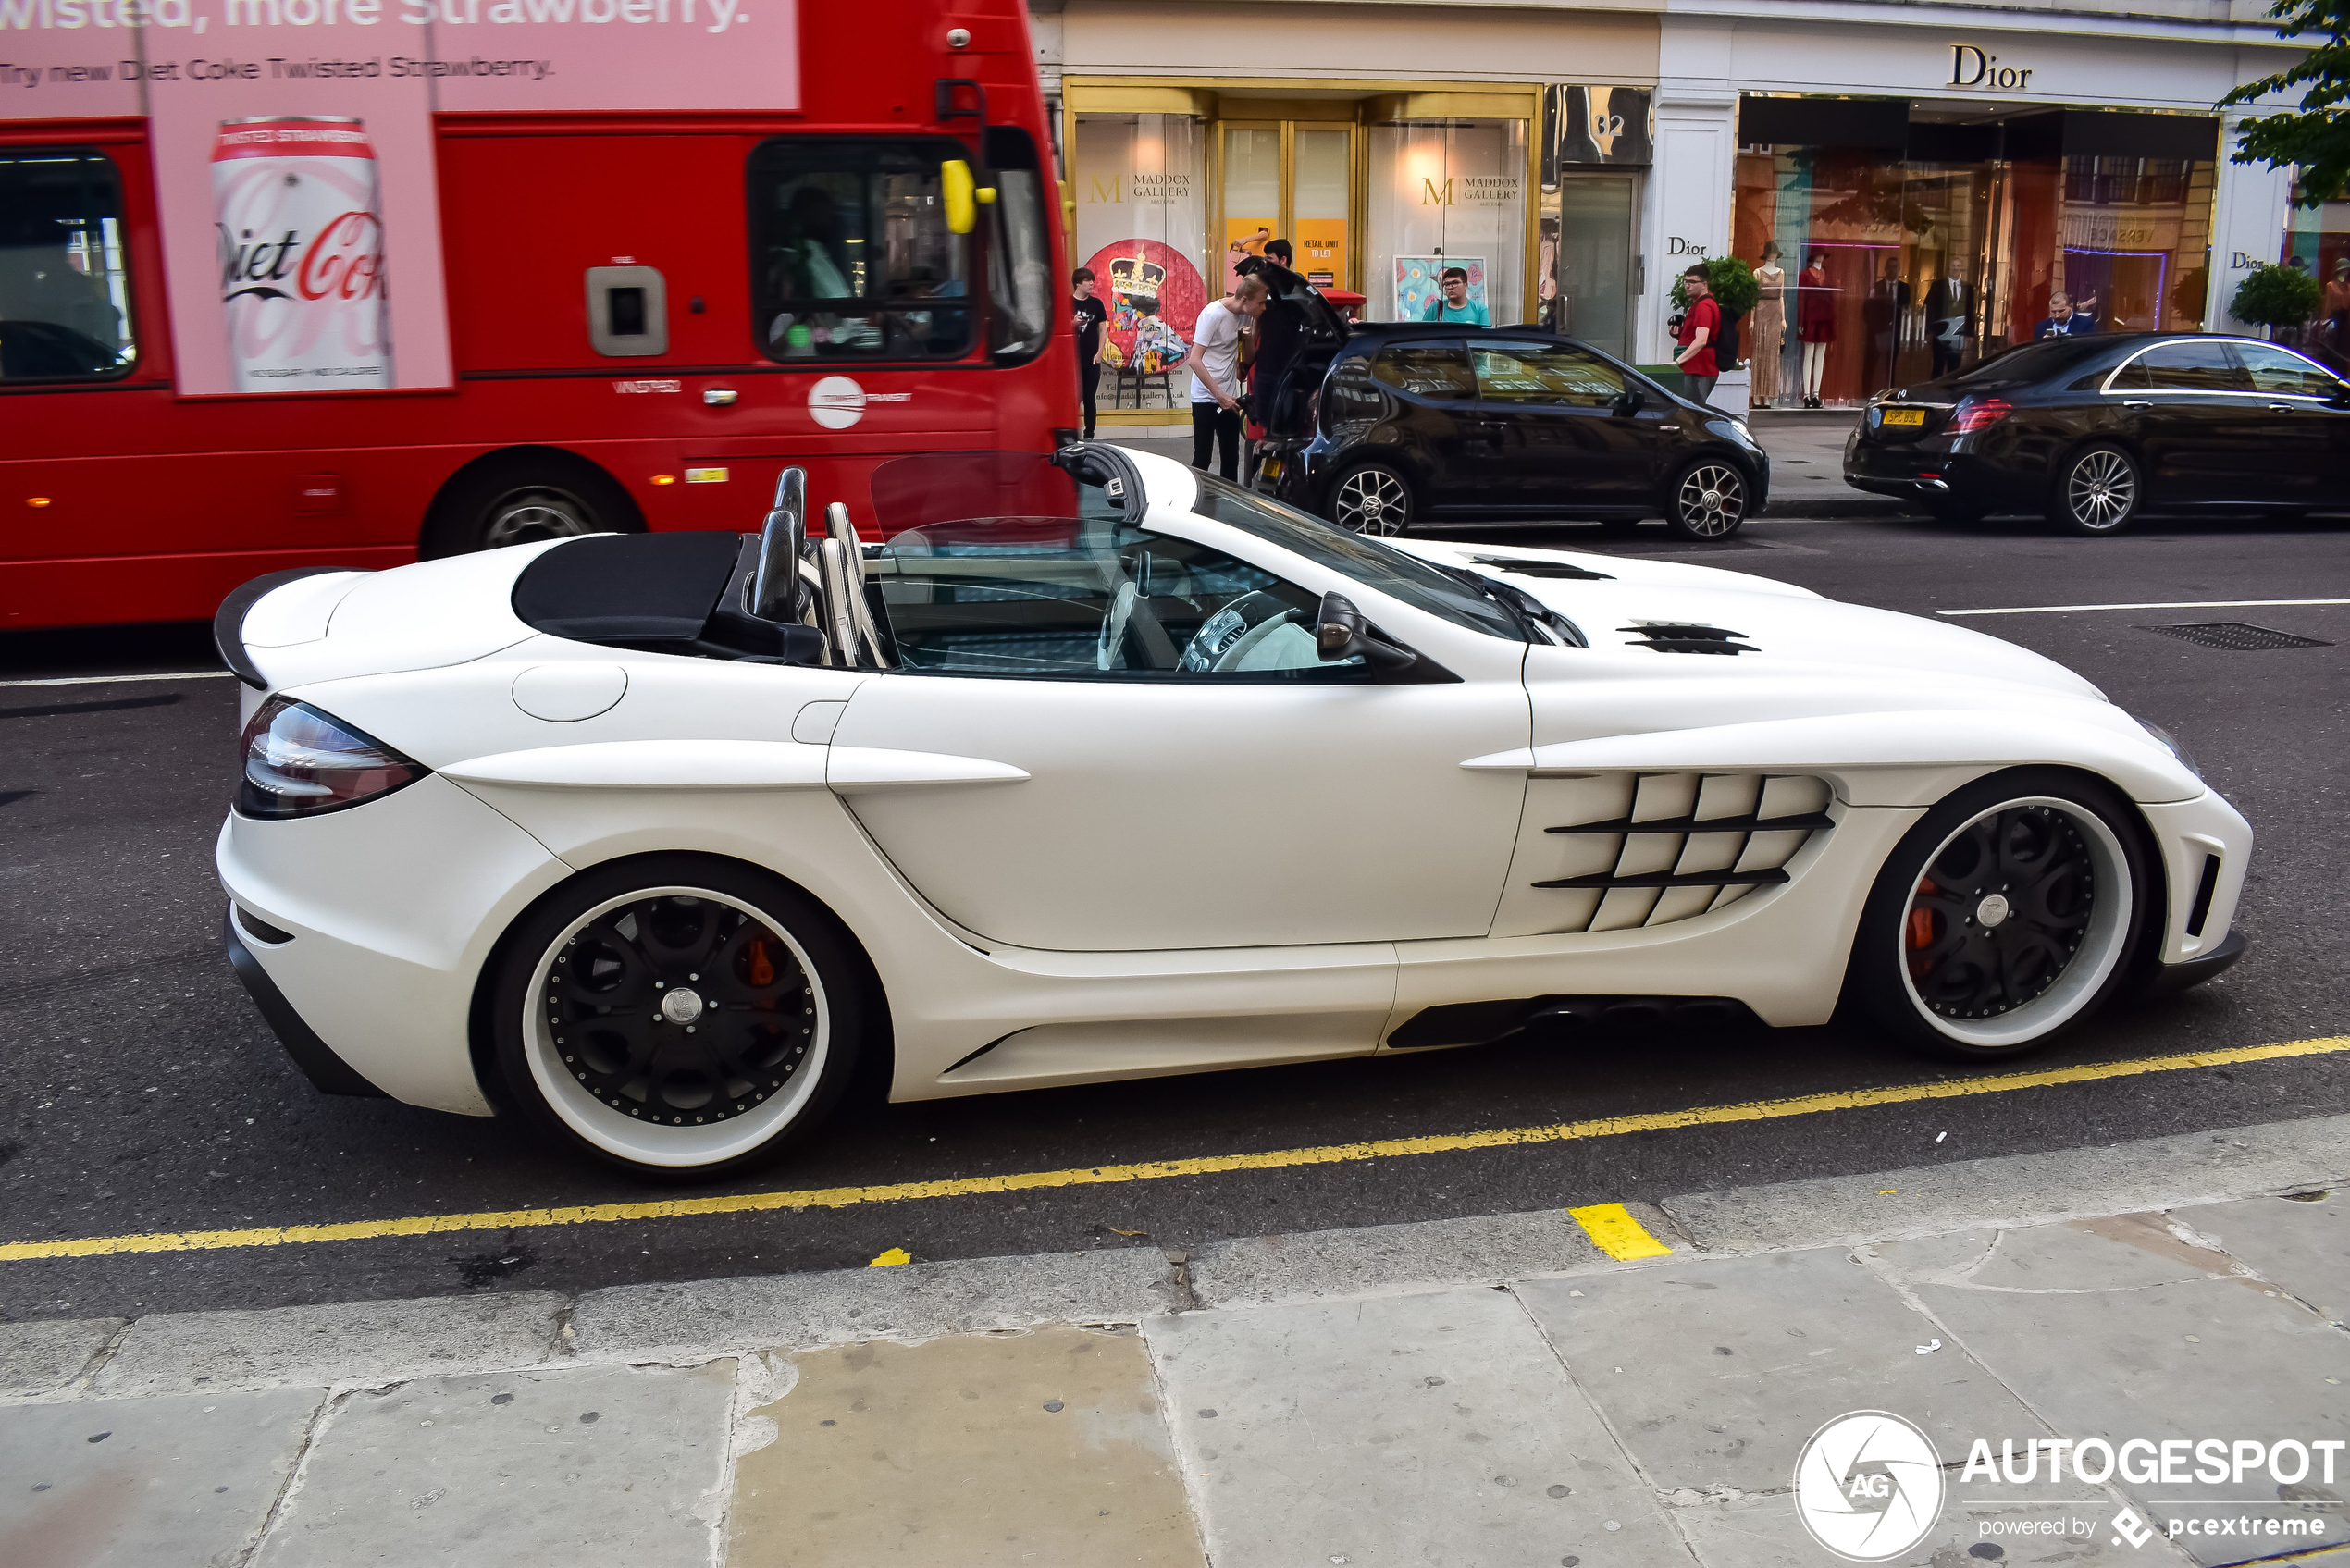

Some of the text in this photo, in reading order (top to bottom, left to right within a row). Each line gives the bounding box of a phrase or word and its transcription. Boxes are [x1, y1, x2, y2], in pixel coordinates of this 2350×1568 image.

[224, 0, 383, 26] more
[398, 0, 750, 33] Strawberry.
[0, 56, 555, 88] Try new Diet Coke Twisted Strawberry.
[1946, 44, 2033, 88] Dior
[1595, 115, 1624, 136] 32
[1133, 174, 1191, 185] MADDOX
[1465, 178, 1518, 188] MADDOX
[1087, 174, 1124, 204] M
[1133, 187, 1191, 197] GALLERY
[1420, 177, 1455, 205] M
[1464, 189, 1518, 200] GALLERY
[1304, 240, 1339, 248] RETAIL UNIT
[1666, 236, 1707, 255] Dior
[1311, 249, 1331, 258] TO LET
[2230, 251, 2265, 269] Dior
